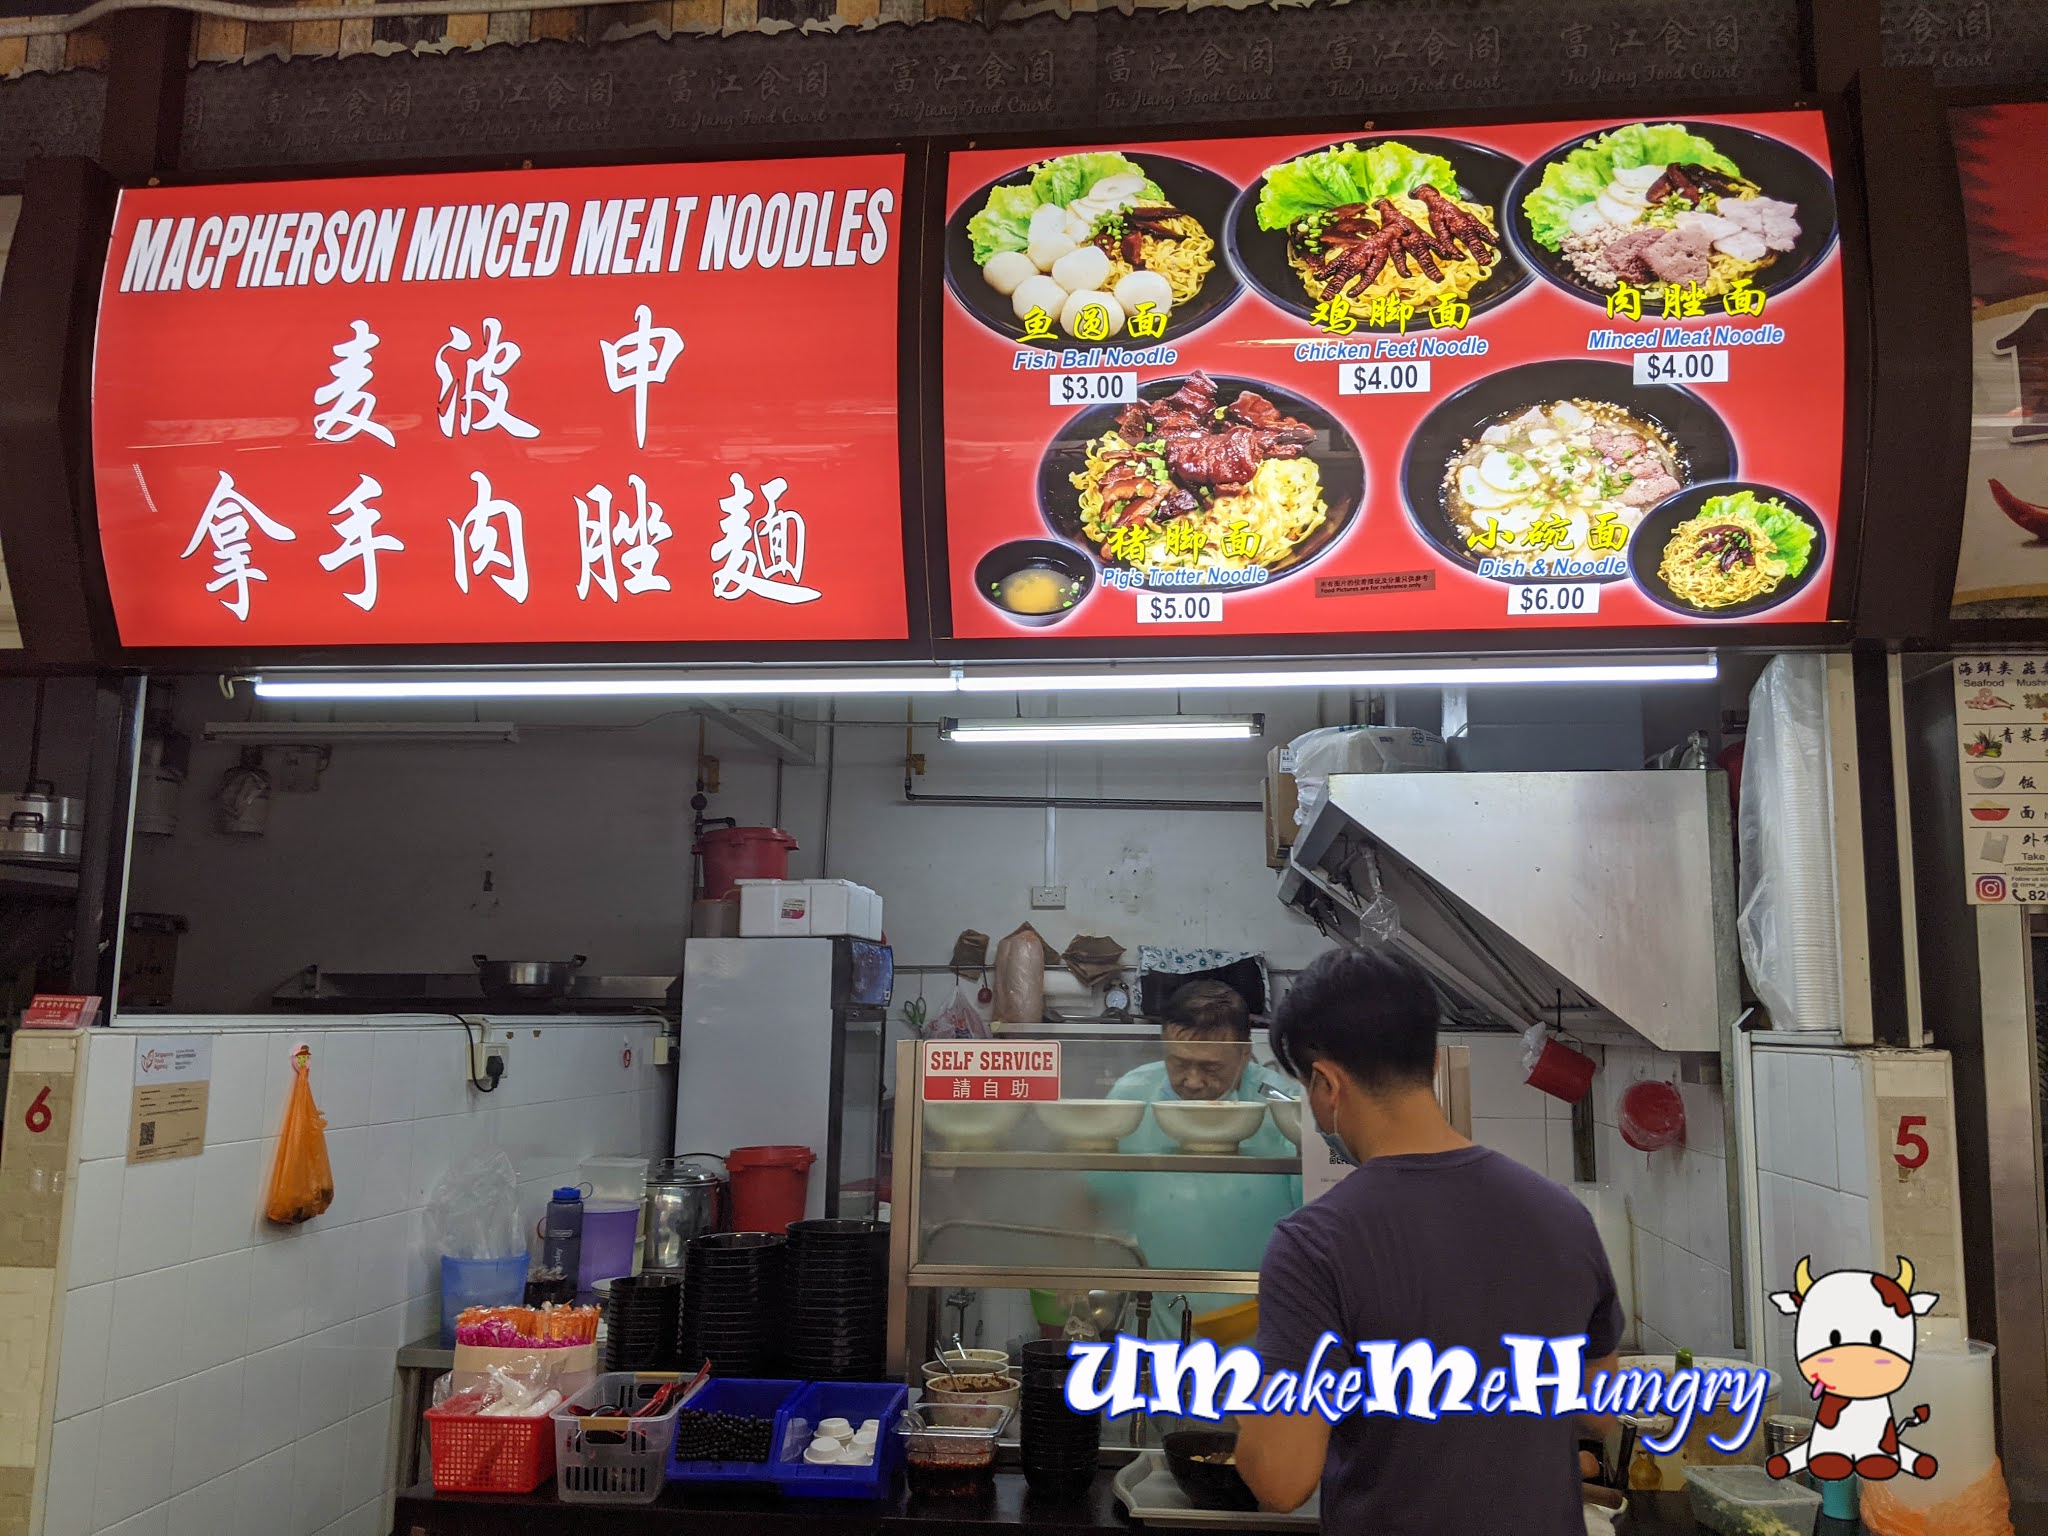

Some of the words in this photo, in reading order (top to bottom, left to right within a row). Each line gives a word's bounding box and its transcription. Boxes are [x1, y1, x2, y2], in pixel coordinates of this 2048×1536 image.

[1326, 25, 1501, 72] 富江食阁
[1560, 14, 1740, 60] 富江食阁
[1104, 36, 1277, 83] 富江食阁
[118, 207, 406, 293] MACPHERSON
[401, 200, 570, 283] MINCED
[570, 196, 700, 276] MEAT
[697, 187, 894, 272] NOODLES
[1015, 300, 1169, 344] 鱼圆面
[1308, 292, 1472, 336] 鸡脚面
[1295, 340, 1370, 362] Chicken
[1375, 339, 1417, 359] Feet
[1420, 336, 1488, 357] Noodle
[1588, 329, 1659, 350] Minced
[1663, 327, 1710, 347] Meat
[1714, 324, 1784, 345] Noodle
[1014, 350, 1057, 370] Fish
[1061, 348, 1101, 368] Ball
[1105, 347, 1177, 367] Noodle
[1647, 353, 1714, 382] $4.00
[313, 303, 686, 449] 麦波申
[1062, 374, 1124, 402] $3.00
[1354, 363, 1418, 394] $4.00
[1107, 520, 1262, 565] 猪脚面
[1466, 511, 1630, 551] 小碗面
[1102, 567, 1145, 589] Pig's
[1148, 567, 1205, 587] Trotter
[1207, 564, 1269, 584] Noodle
[1477, 558, 1526, 578] Dish
[1530, 558, 1548, 577] &
[1552, 556, 1629, 577] Noodle
[1150, 596, 1211, 621] $5.00
[1520, 587, 1585, 613] $6.00
[1963, 679, 2005, 688] Seafood
[2020, 804, 2035, 820] 面
[2020, 852, 2045, 861] Take
[2028, 890, 2048, 901] 82
[930, 1051, 974, 1071] SELF
[979, 1051, 1053, 1071] SERVICE
[952, 1077, 1030, 1099] 請自助
[25, 1085, 52, 1133] 6
[1893, 1115, 1929, 1169] 5
